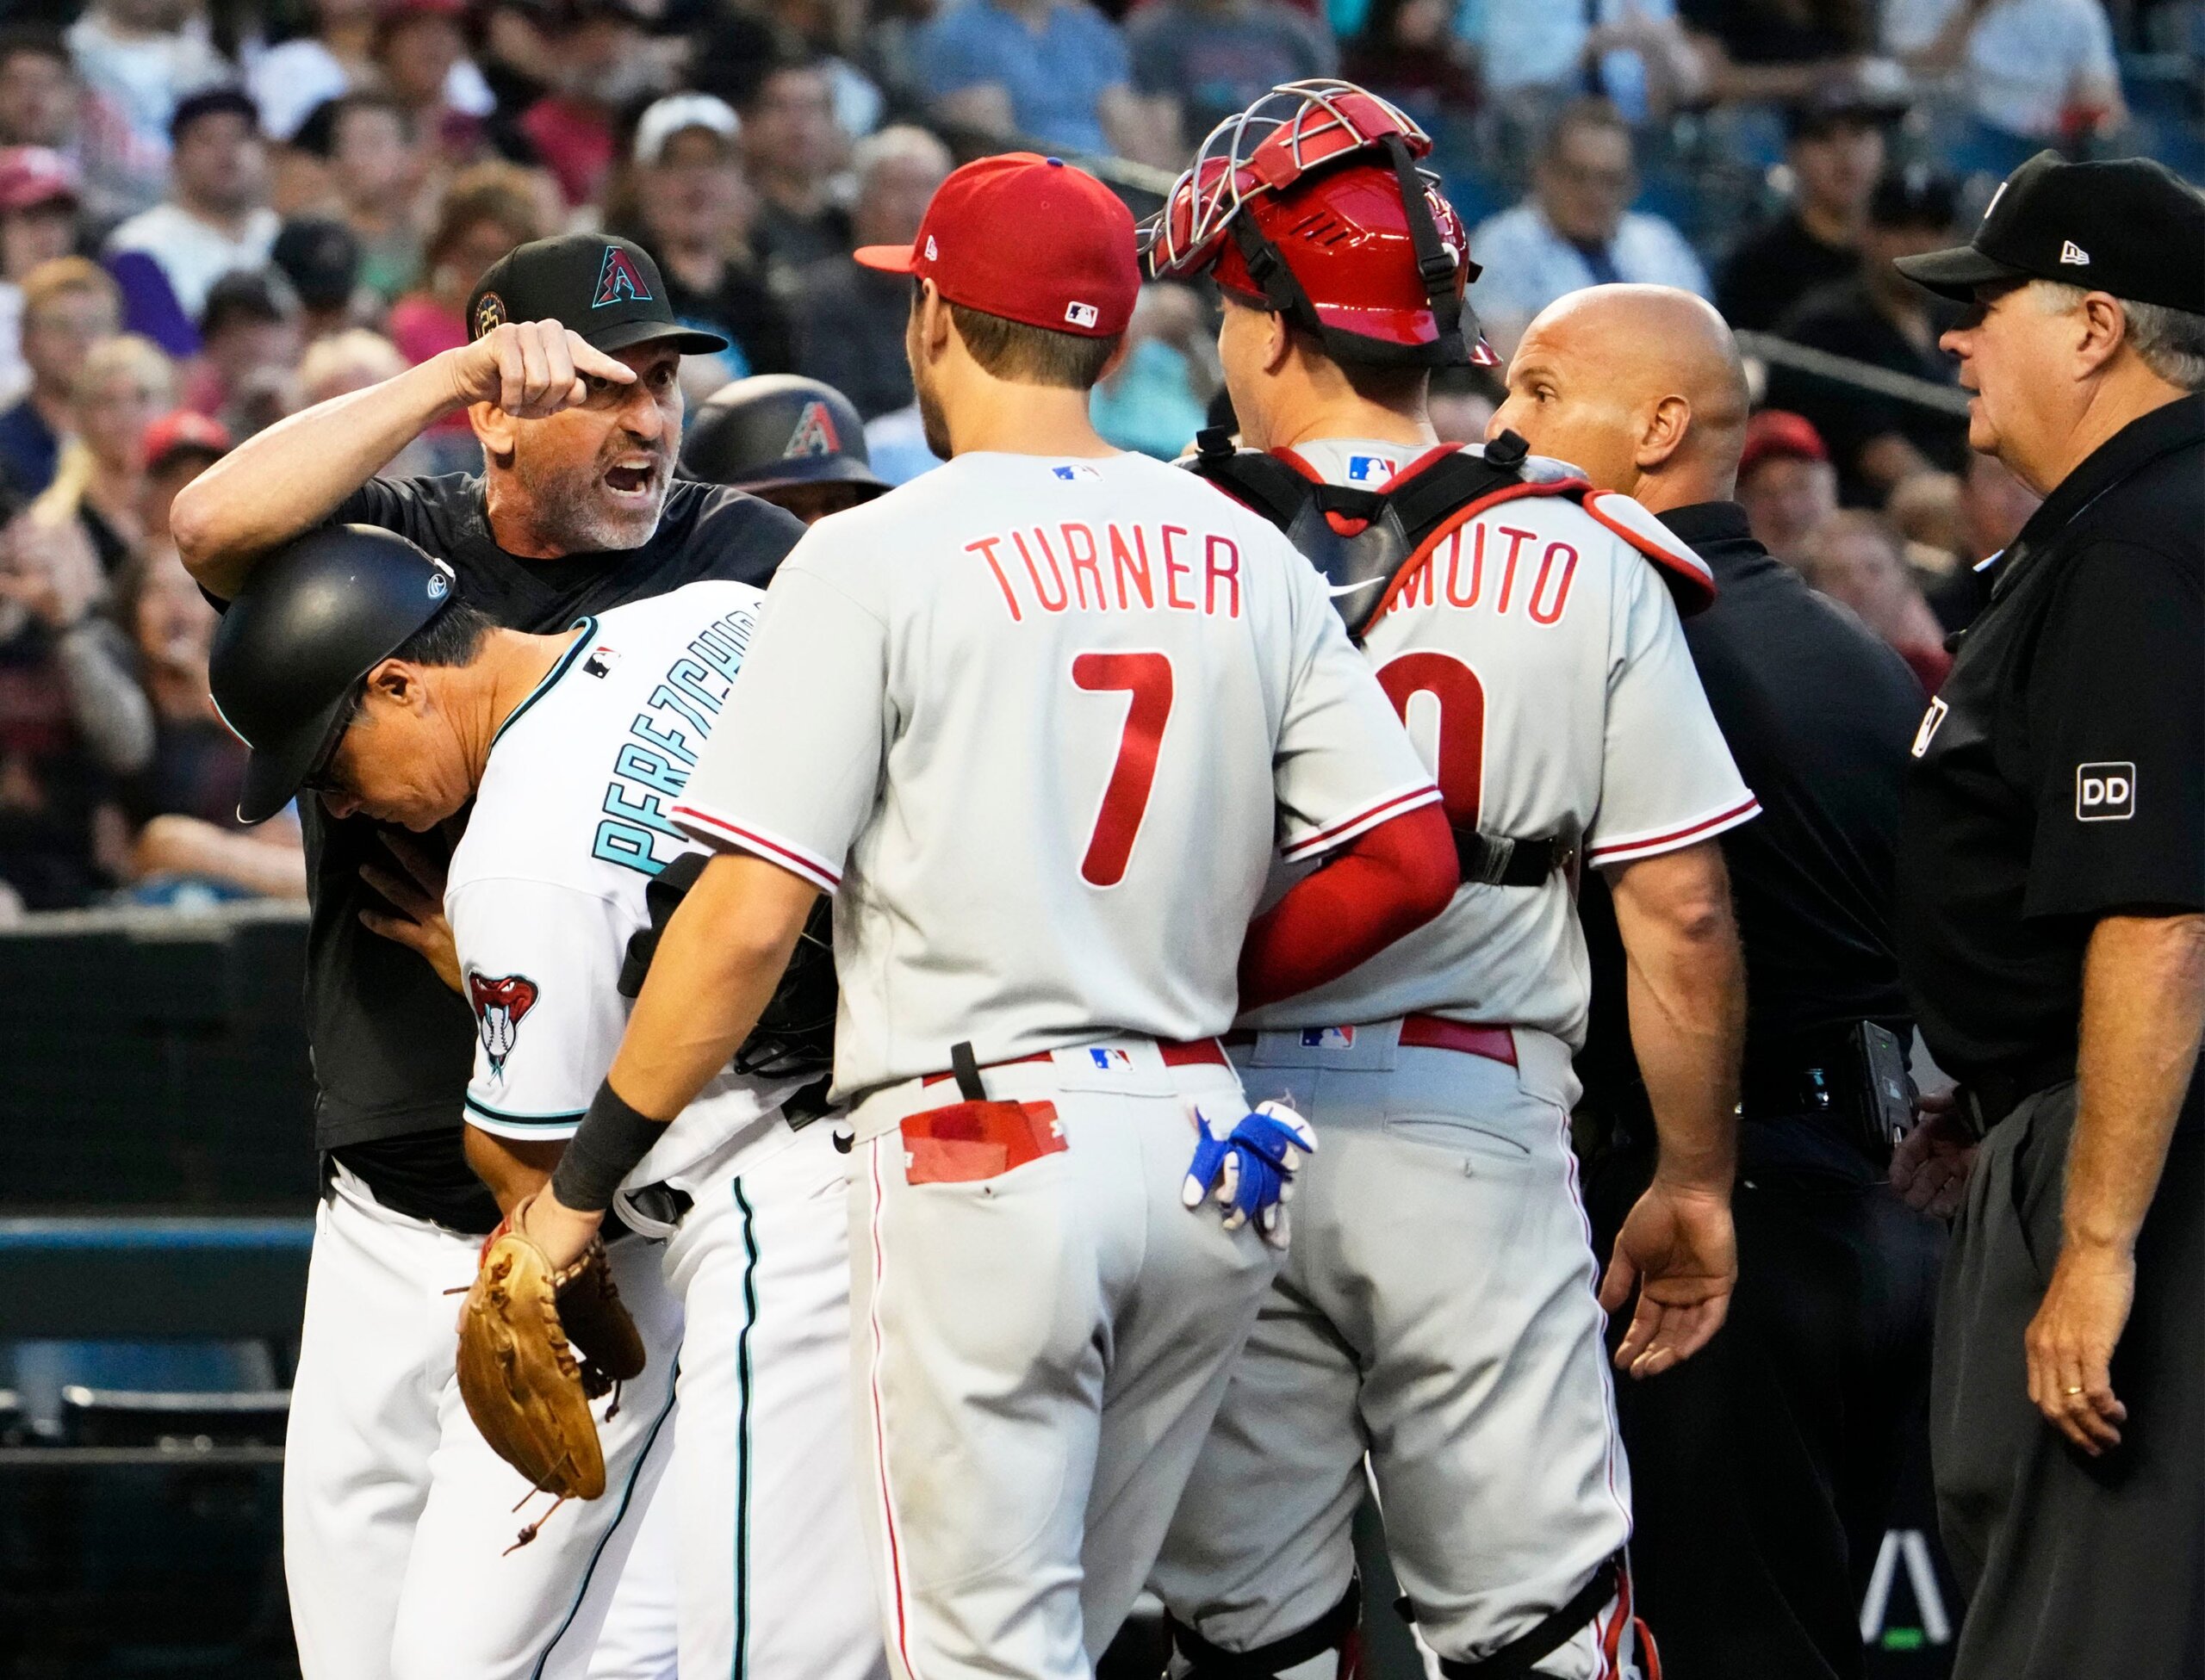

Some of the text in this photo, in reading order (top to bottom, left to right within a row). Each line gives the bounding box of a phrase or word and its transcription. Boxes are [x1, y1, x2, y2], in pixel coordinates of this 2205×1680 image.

[963, 521, 1241, 623] TURNER
[592, 602, 761, 877] PEREZCHI
[1070, 648, 1175, 890] 7
[2083, 777, 2129, 806] DD
